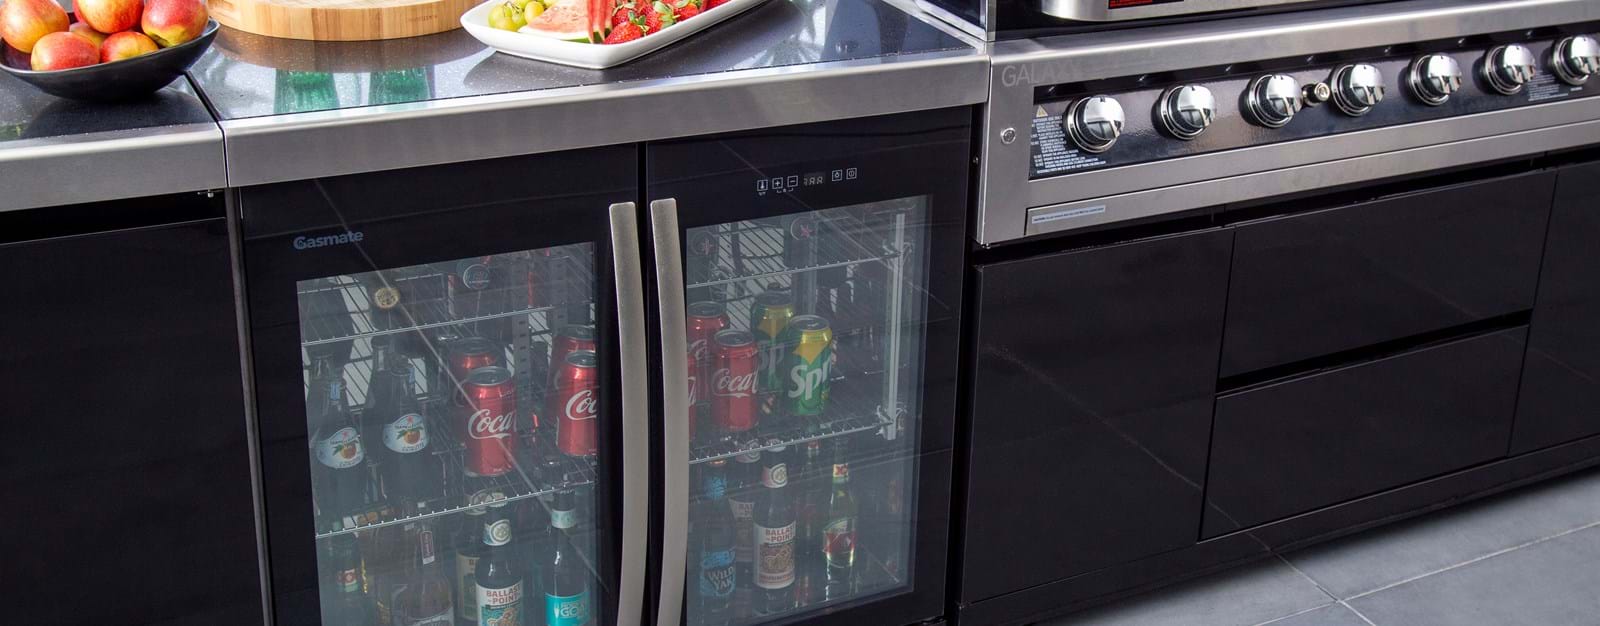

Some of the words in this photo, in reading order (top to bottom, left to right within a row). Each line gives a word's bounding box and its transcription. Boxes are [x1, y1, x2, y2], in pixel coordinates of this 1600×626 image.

[293, 230, 364, 250] Gasmate
[708, 566, 734, 581] WILD
[714, 575, 734, 590] YAK
[493, 593, 518, 605] POINT
